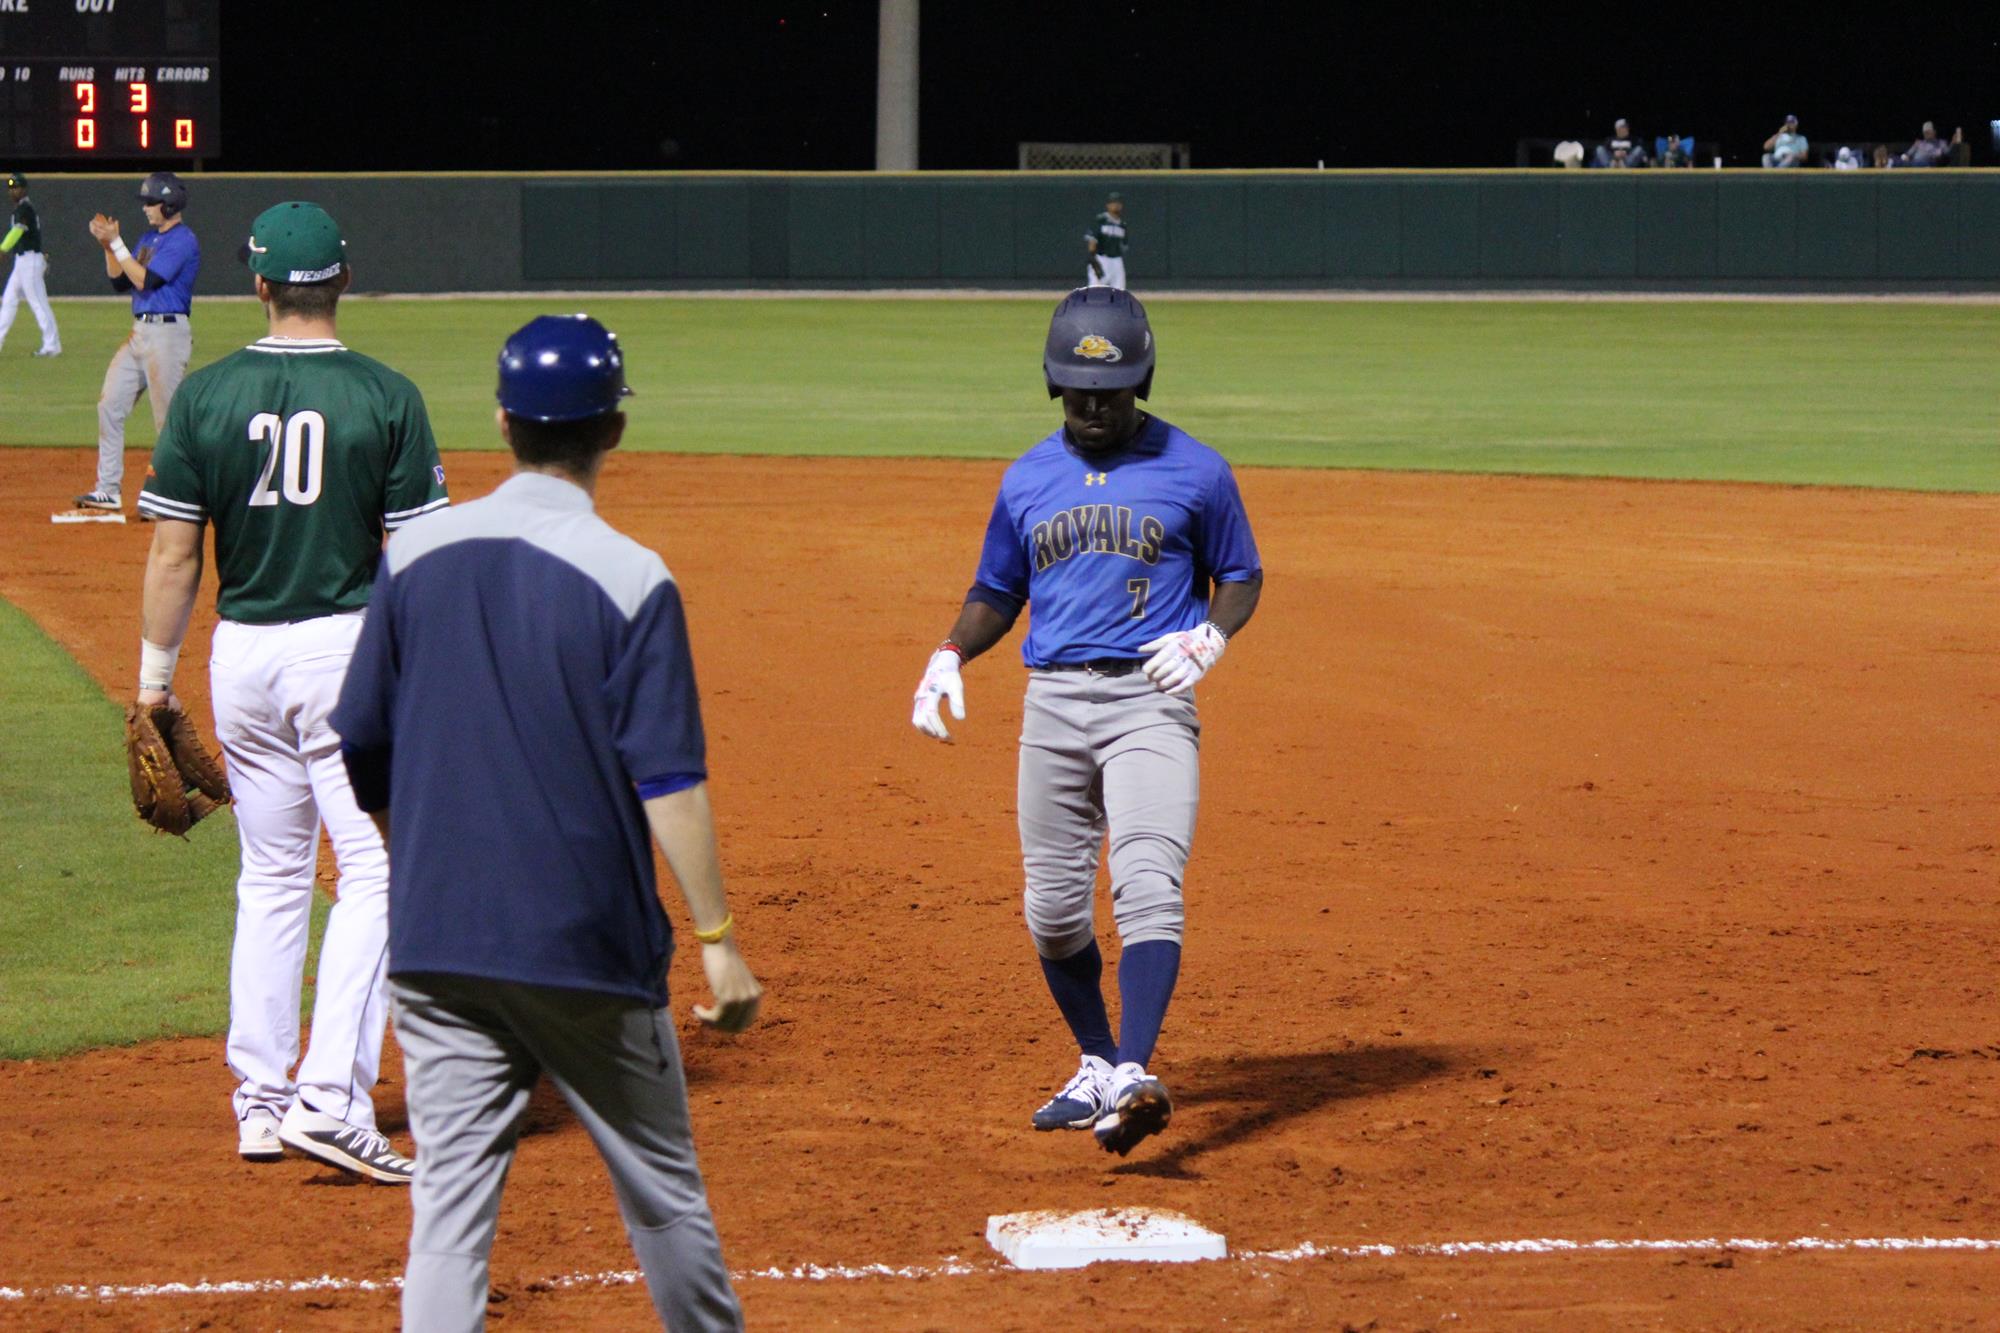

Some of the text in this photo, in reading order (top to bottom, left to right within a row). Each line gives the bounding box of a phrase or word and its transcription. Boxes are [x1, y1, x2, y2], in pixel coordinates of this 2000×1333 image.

[14, 66, 31, 81] 10
[59, 66, 95, 81] RUNS
[114, 66, 146, 81] HITS
[156, 66, 210, 82] ERRORS
[130, 83, 147, 112] 3
[77, 119, 193, 148] 0 1 0
[247, 409, 326, 507] 20
[1031, 504, 1165, 573] ROYALS
[1127, 578, 1150, 618] 7
